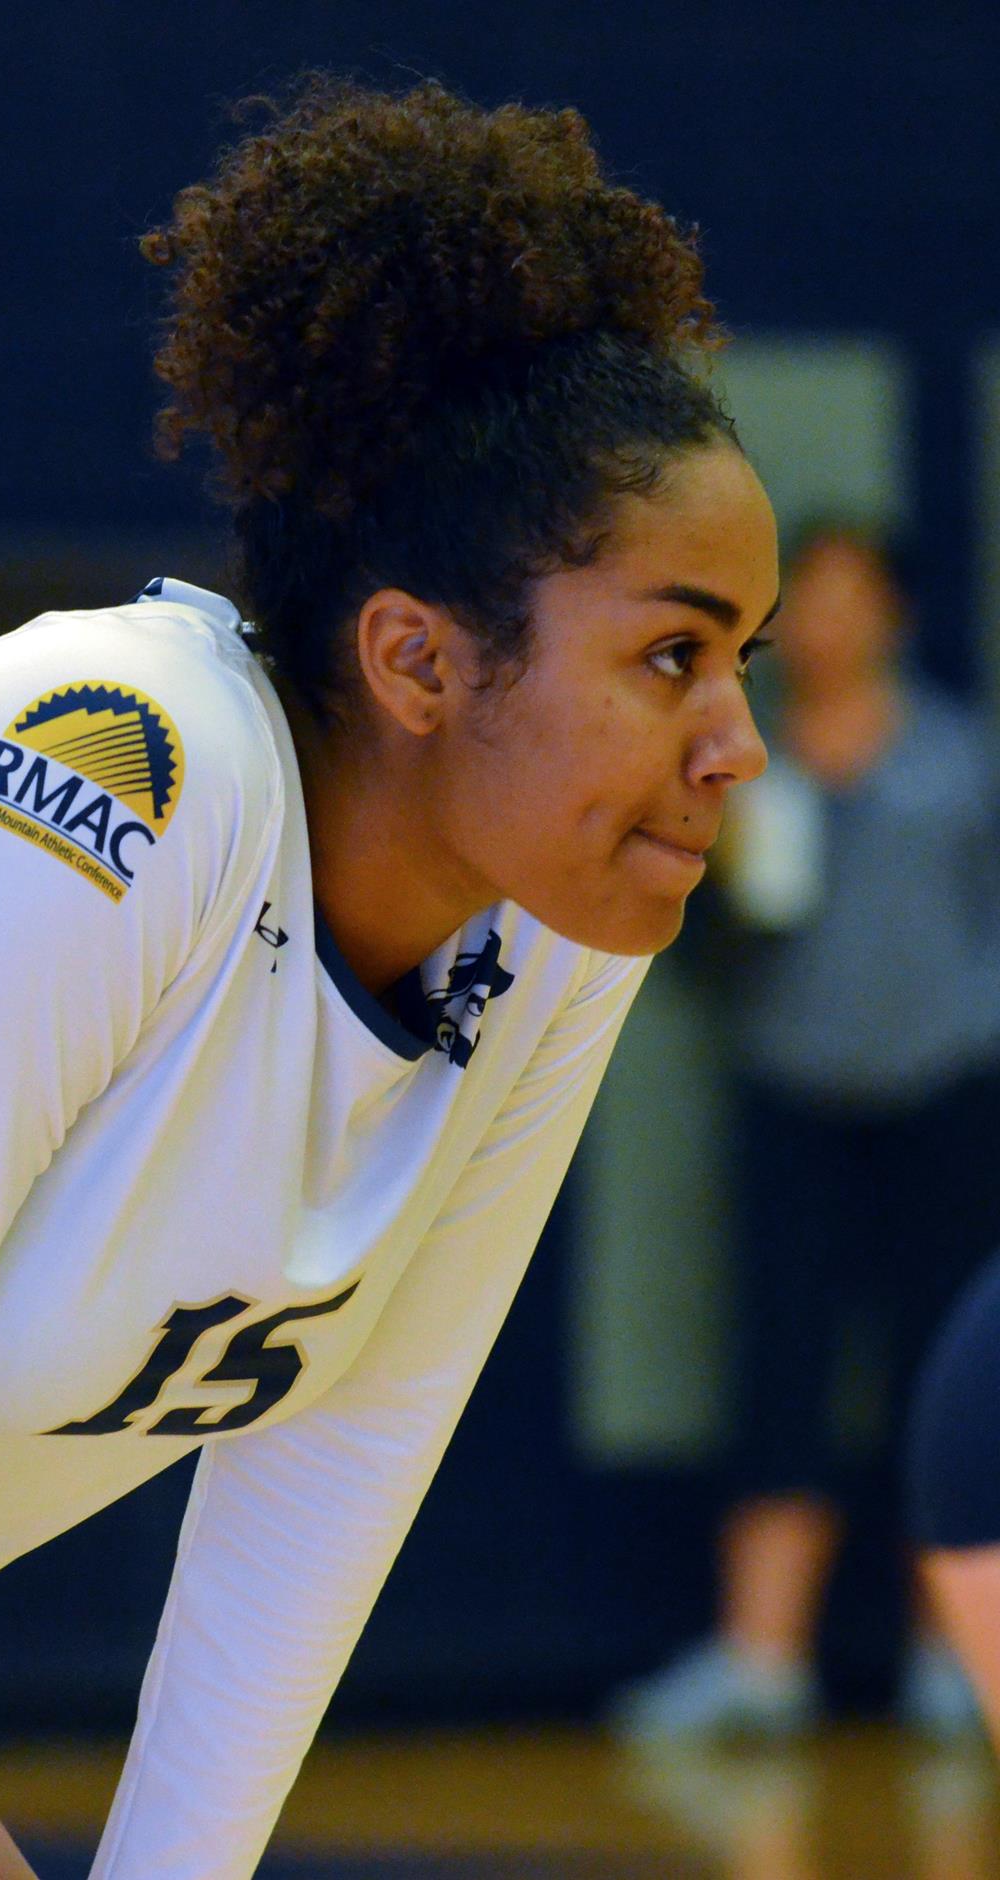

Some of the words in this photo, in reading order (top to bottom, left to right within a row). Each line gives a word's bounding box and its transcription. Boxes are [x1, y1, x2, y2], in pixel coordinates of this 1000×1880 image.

[40, 832, 76, 863] Athletic
[75, 855, 123, 900] Conference
[36, 1276, 363, 1436] 15
